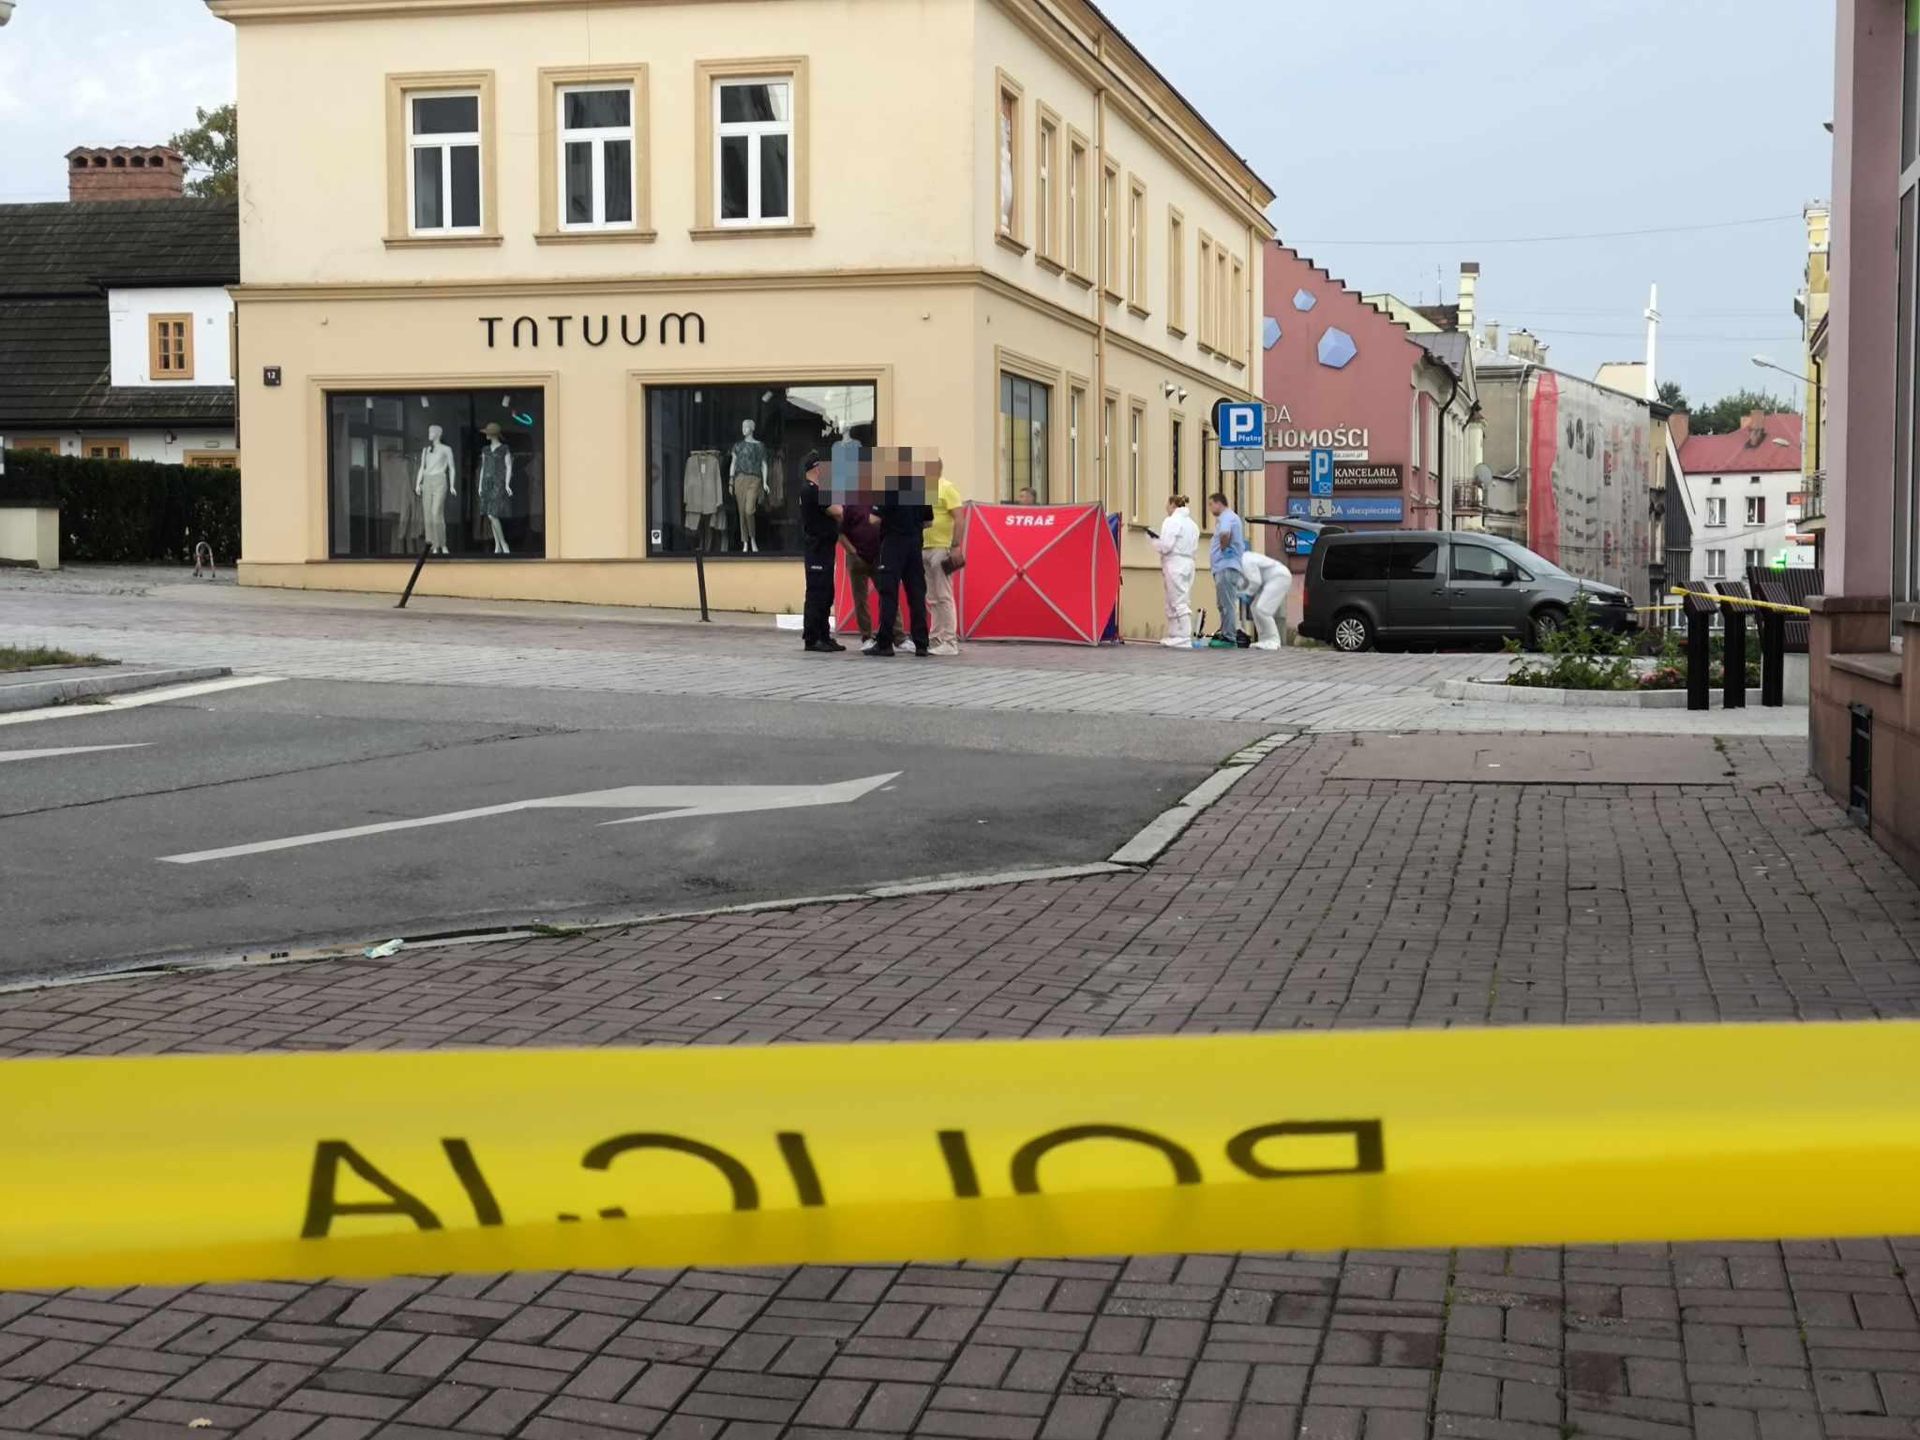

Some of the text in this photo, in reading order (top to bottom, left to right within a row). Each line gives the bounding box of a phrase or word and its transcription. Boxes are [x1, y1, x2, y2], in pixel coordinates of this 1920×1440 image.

[478, 312, 705, 348] TATUUM
[1229, 407, 1255, 442] P
[1264, 422, 1369, 448] HOMOŚCI
[1315, 452, 1329, 482] P
[1334, 468, 1397, 478] KANCELARIA
